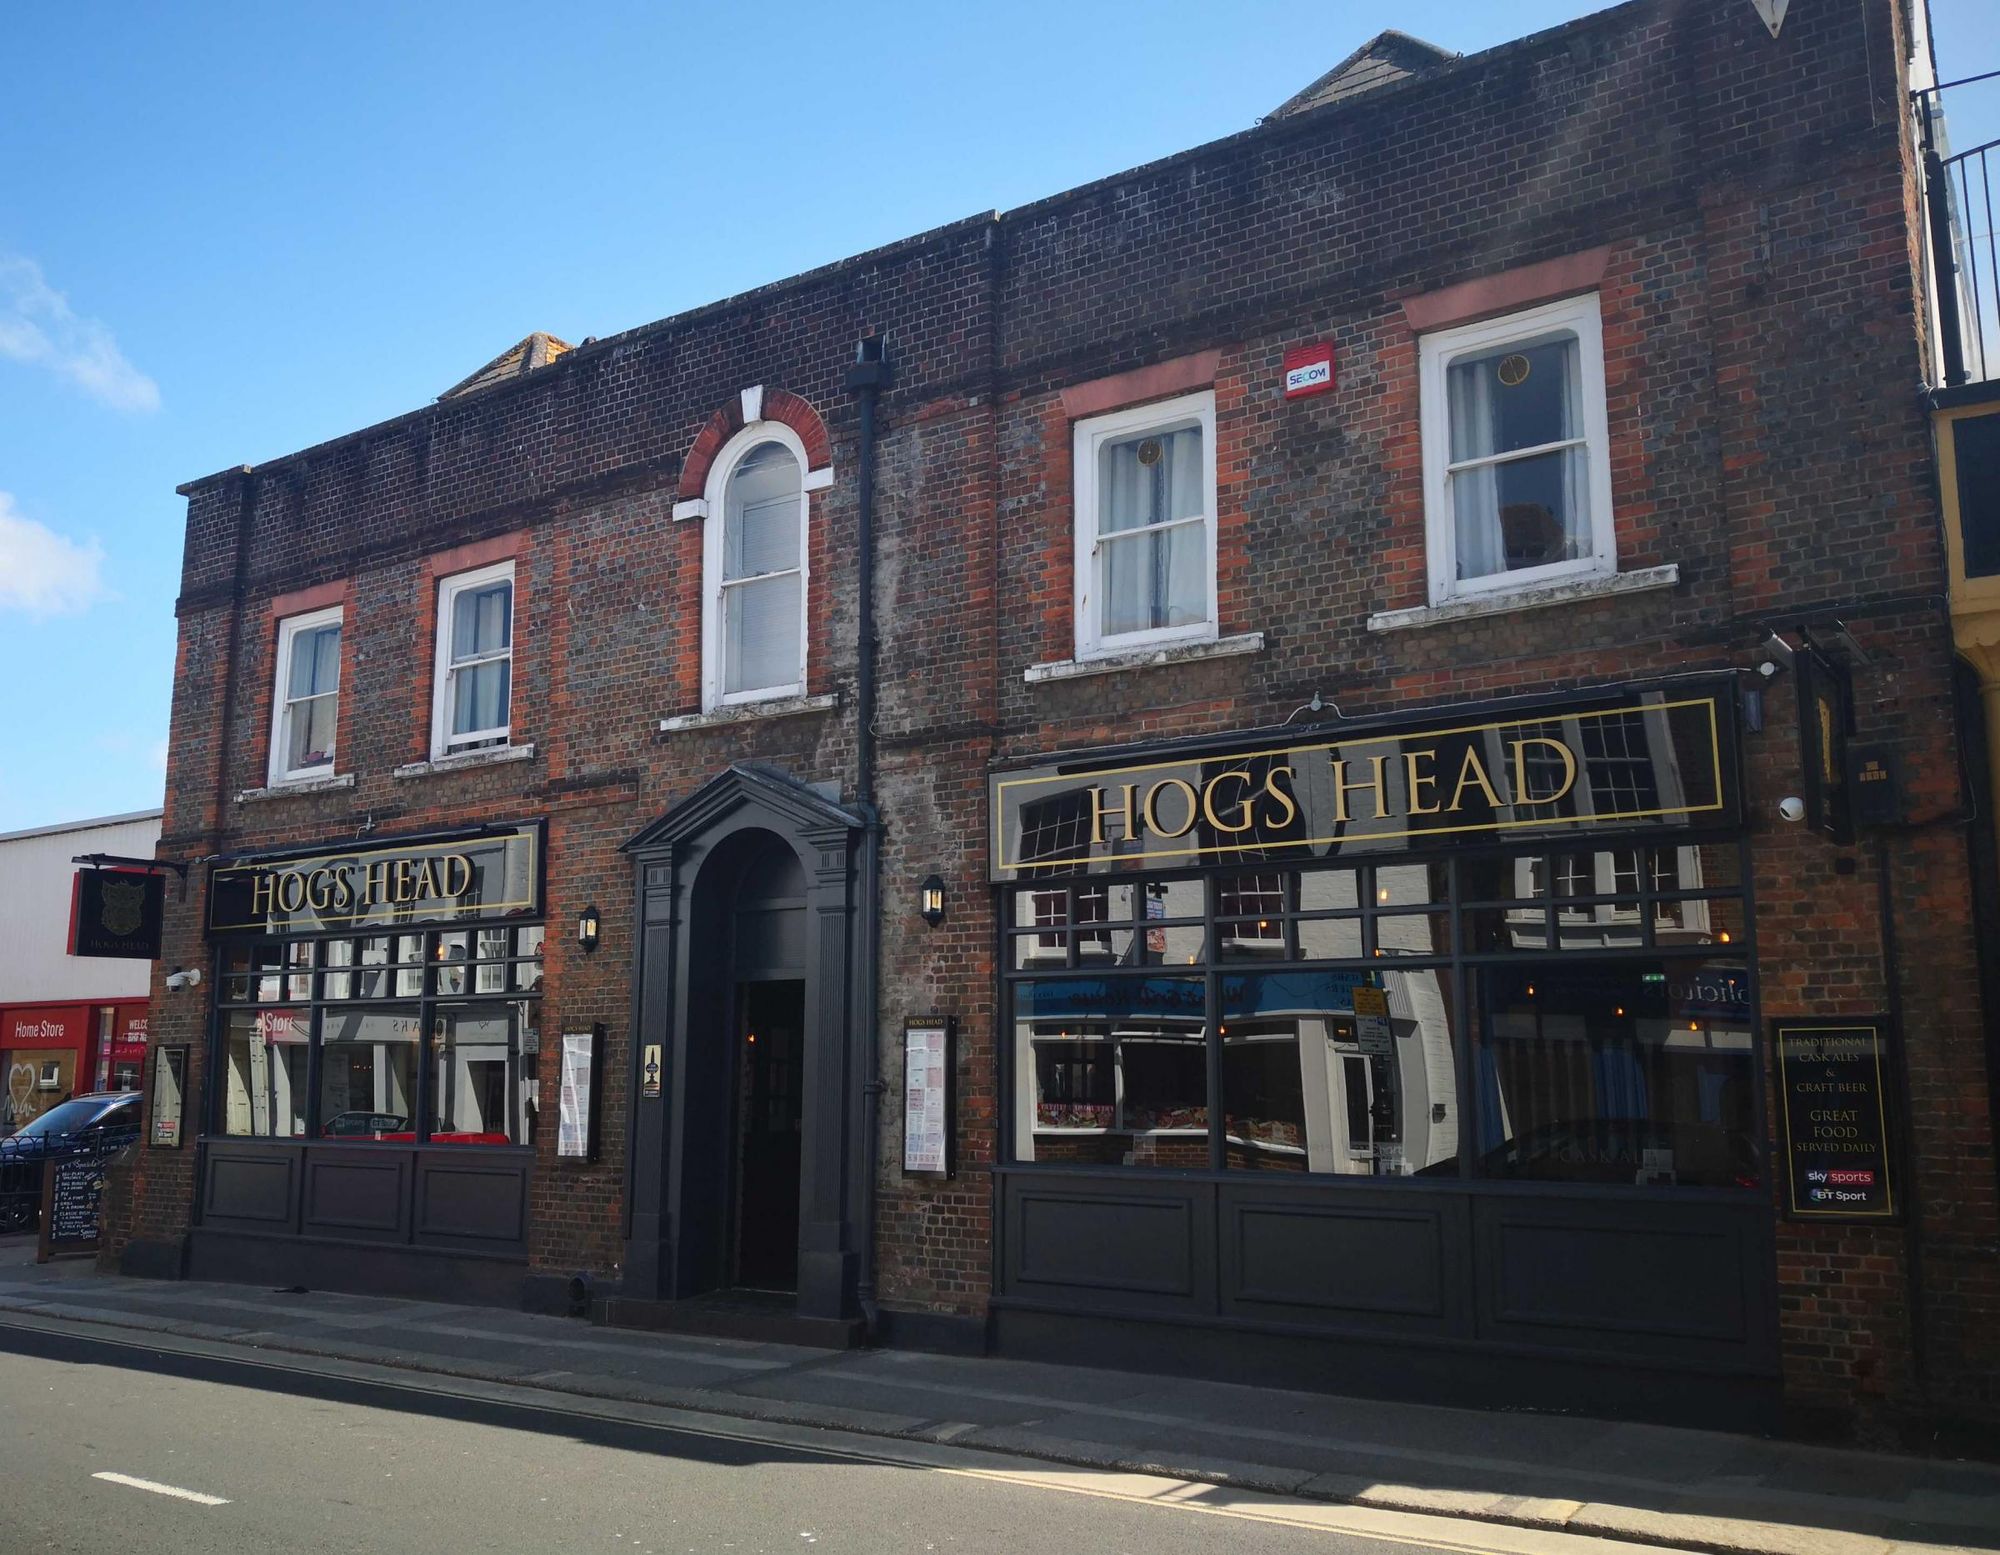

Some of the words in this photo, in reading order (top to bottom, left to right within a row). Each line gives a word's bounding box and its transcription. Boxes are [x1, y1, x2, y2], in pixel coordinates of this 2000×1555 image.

[1289, 367, 1326, 385] SECOM
[1088, 766, 1298, 845] HOGS
[1332, 737, 1578, 822] HEAD
[251, 867, 353, 914] HOGS
[364, 854, 474, 905] HEAD
[15, 1021, 39, 1038] Home
[40, 1020, 65, 1038] Store
[1789, 1037, 1867, 1048] TRADITIONAL
[1798, 1052, 1830, 1063] CASK
[1831, 1052, 1860, 1063] ALES
[1825, 1067, 1837, 1078] &
[1796, 1082, 1834, 1093] CRAFT
[1837, 1082, 1869, 1093] BEER
[1809, 1109, 1859, 1122] GREAT
[1813, 1126, 1859, 1139] FOOD
[1796, 1142, 1840, 1153] SERVED
[1843, 1142, 1877, 1153] DAILY
[1808, 1170, 1828, 1184] sky
[1830, 1172, 1872, 1184] sports
[1816, 1190, 1835, 1200] BT
[1835, 1190, 1867, 1202] Sport
